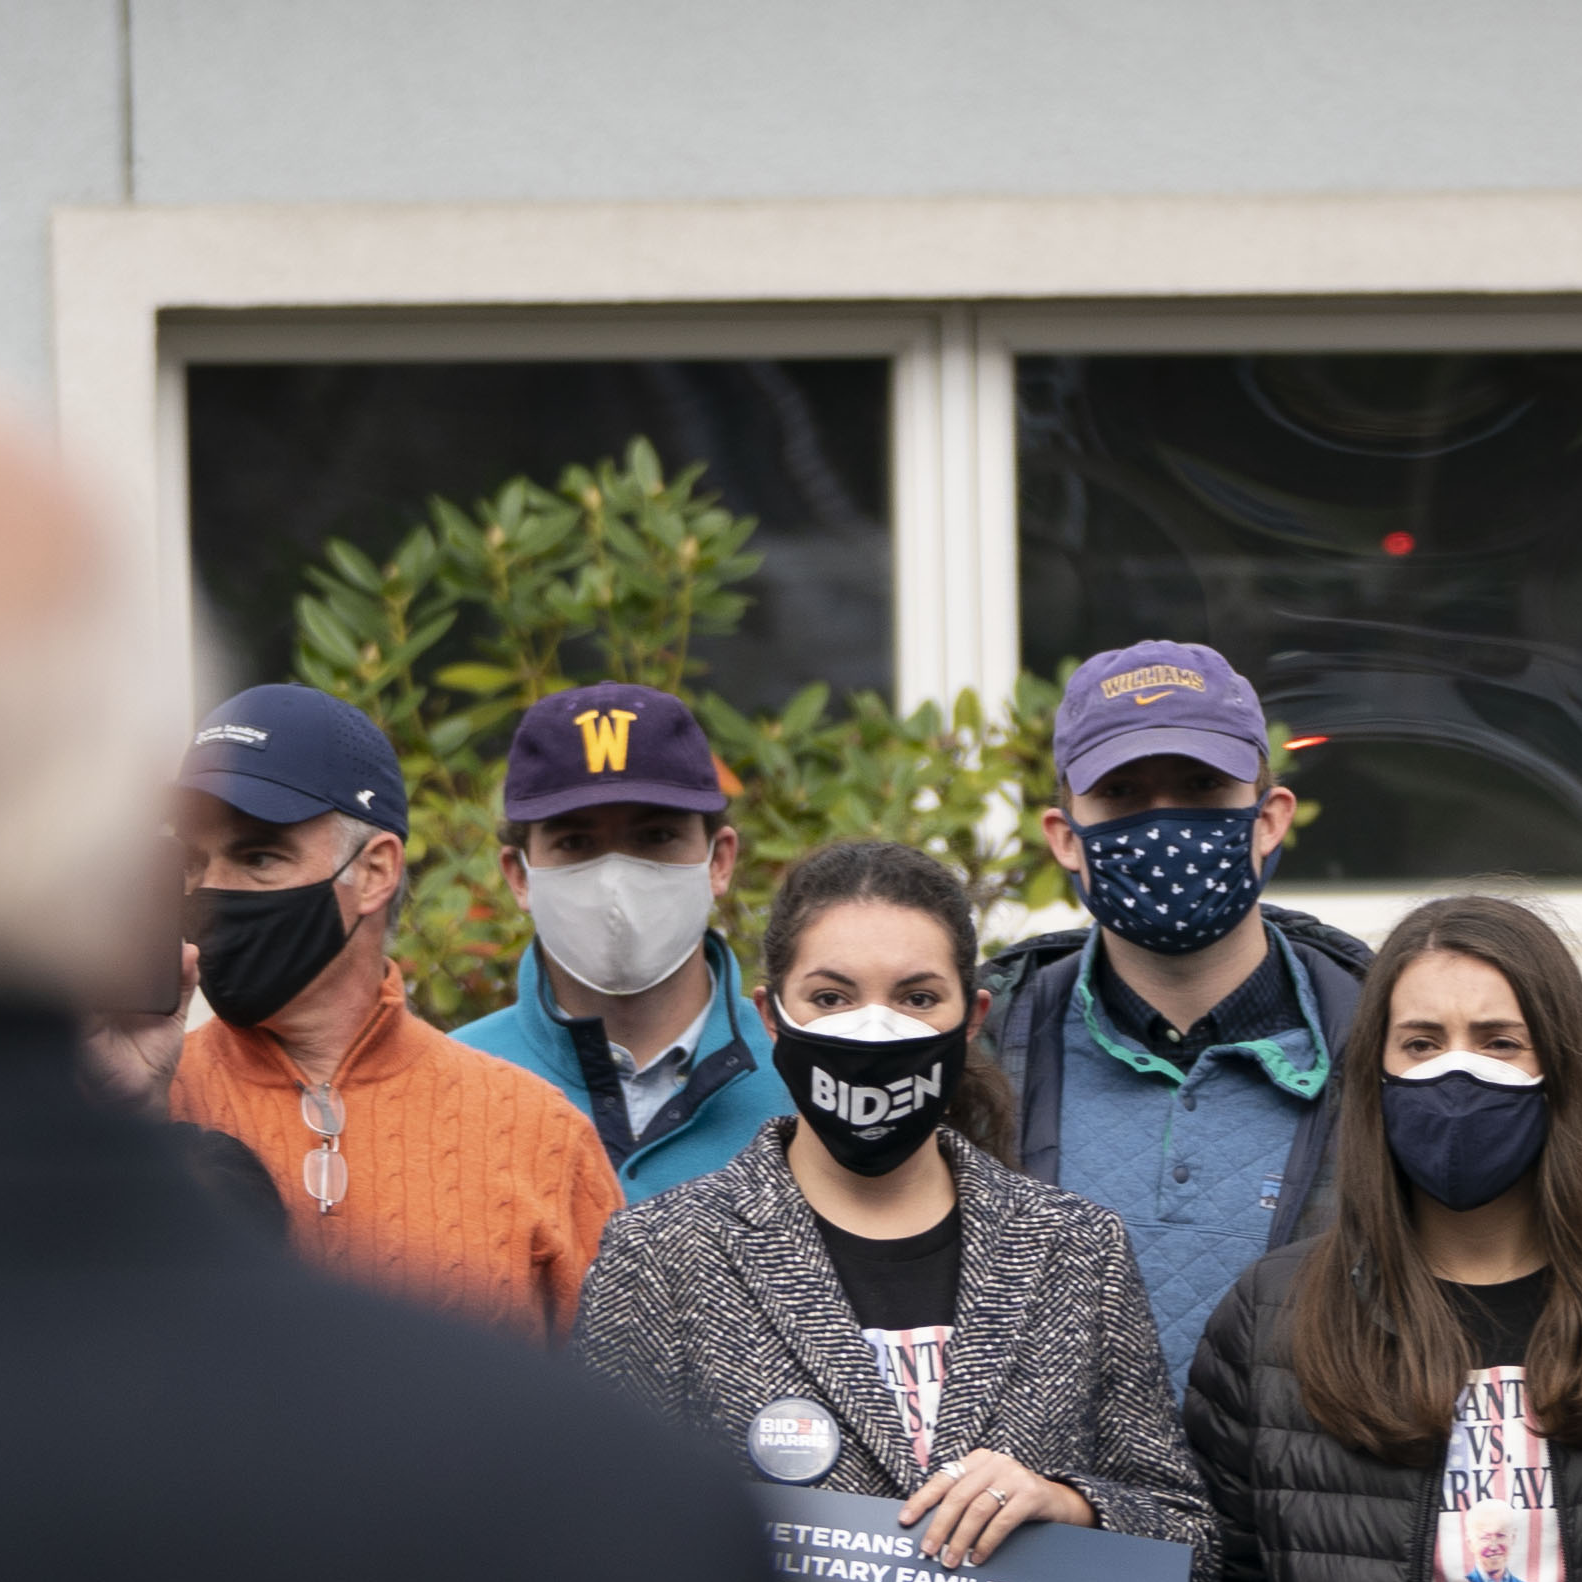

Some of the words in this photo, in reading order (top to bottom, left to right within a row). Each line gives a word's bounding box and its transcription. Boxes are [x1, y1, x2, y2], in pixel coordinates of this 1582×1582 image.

[1100, 665, 1206, 699] WILLIAMS
[574, 709, 638, 773] W
[811, 1062, 942, 1126] BIDEN
[760, 1418, 829, 1435] BIDEN
[767, 1522, 913, 1558] ETERANS
